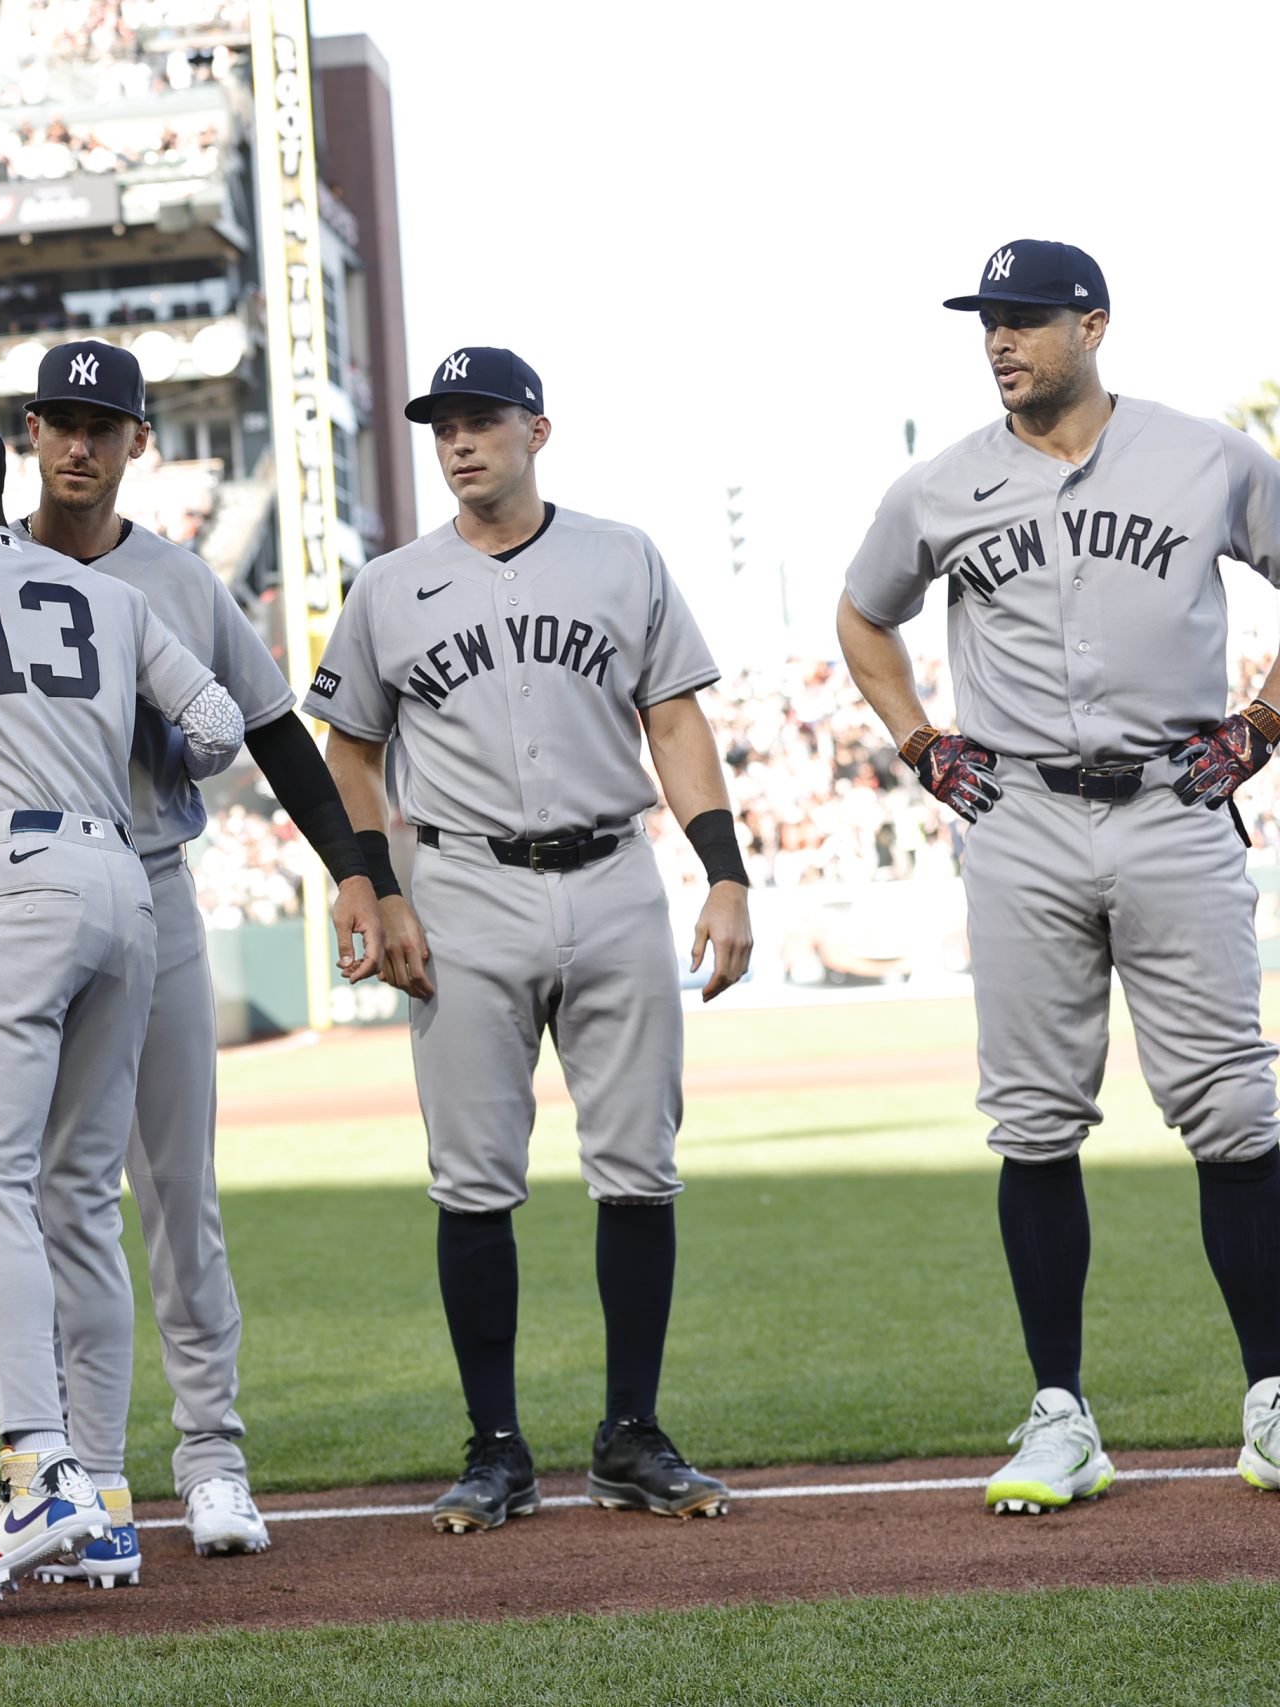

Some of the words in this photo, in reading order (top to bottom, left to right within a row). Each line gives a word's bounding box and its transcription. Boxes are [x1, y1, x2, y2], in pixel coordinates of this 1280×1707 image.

[987, 248, 1015, 281] NY
[68, 353, 100, 385] NY
[442, 352, 471, 382] NY
[959, 519, 1046, 604] NEW
[1062, 509, 1189, 580] YORK
[408, 623, 496, 710] NEW
[505, 614, 618, 687] YORK
[112, 1532, 133, 1556] 13
